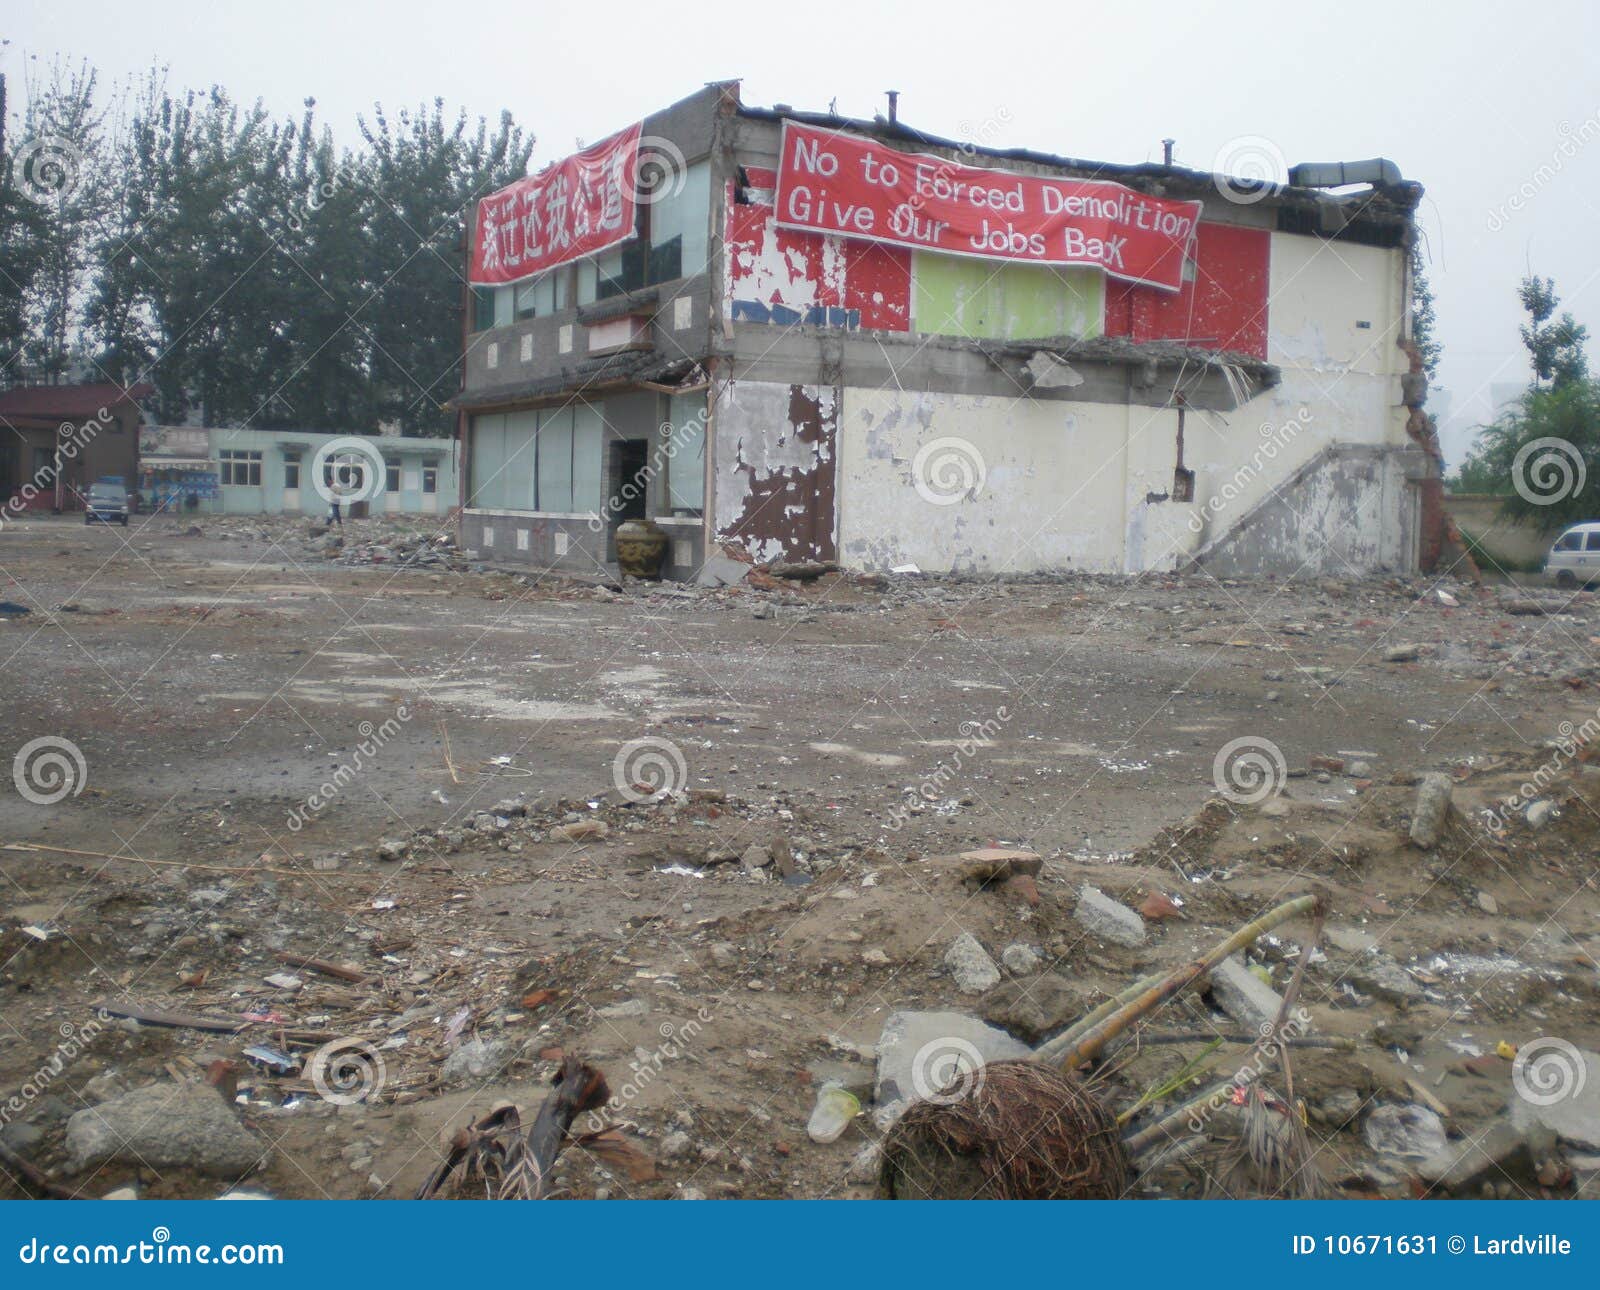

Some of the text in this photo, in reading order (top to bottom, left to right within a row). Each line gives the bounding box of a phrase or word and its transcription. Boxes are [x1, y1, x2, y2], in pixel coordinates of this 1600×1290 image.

[789, 186, 875, 230] Give
[894, 203, 949, 242] Our
[970, 219, 1046, 256] Jobs
[794, 136, 1191, 237] No to Forced Demolition
